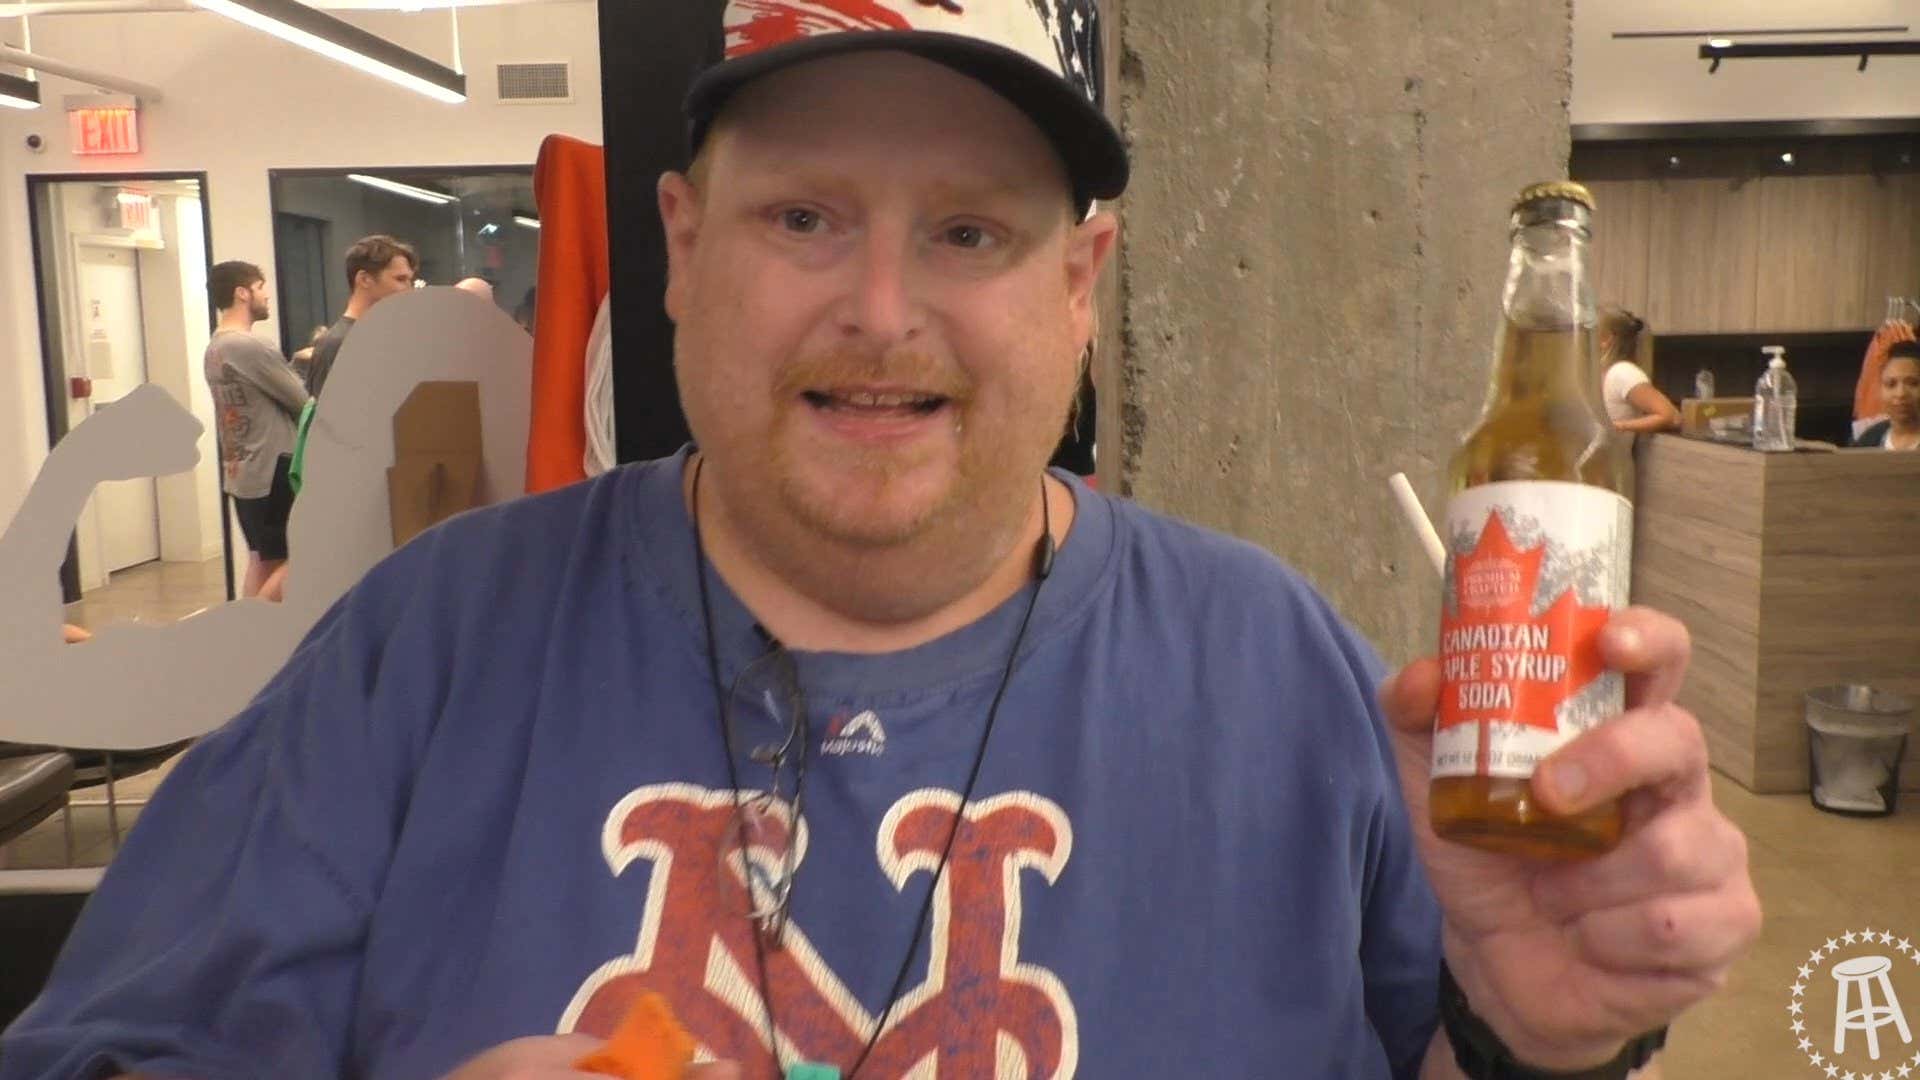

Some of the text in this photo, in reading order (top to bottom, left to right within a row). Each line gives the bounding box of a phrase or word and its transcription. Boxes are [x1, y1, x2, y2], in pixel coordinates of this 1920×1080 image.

[79, 109, 131, 151] EXIT
[1443, 624, 1549, 653] CANADIAN
[1443, 652, 1567, 682] APLE SYRUP
[1458, 682, 1512, 710] SODA
